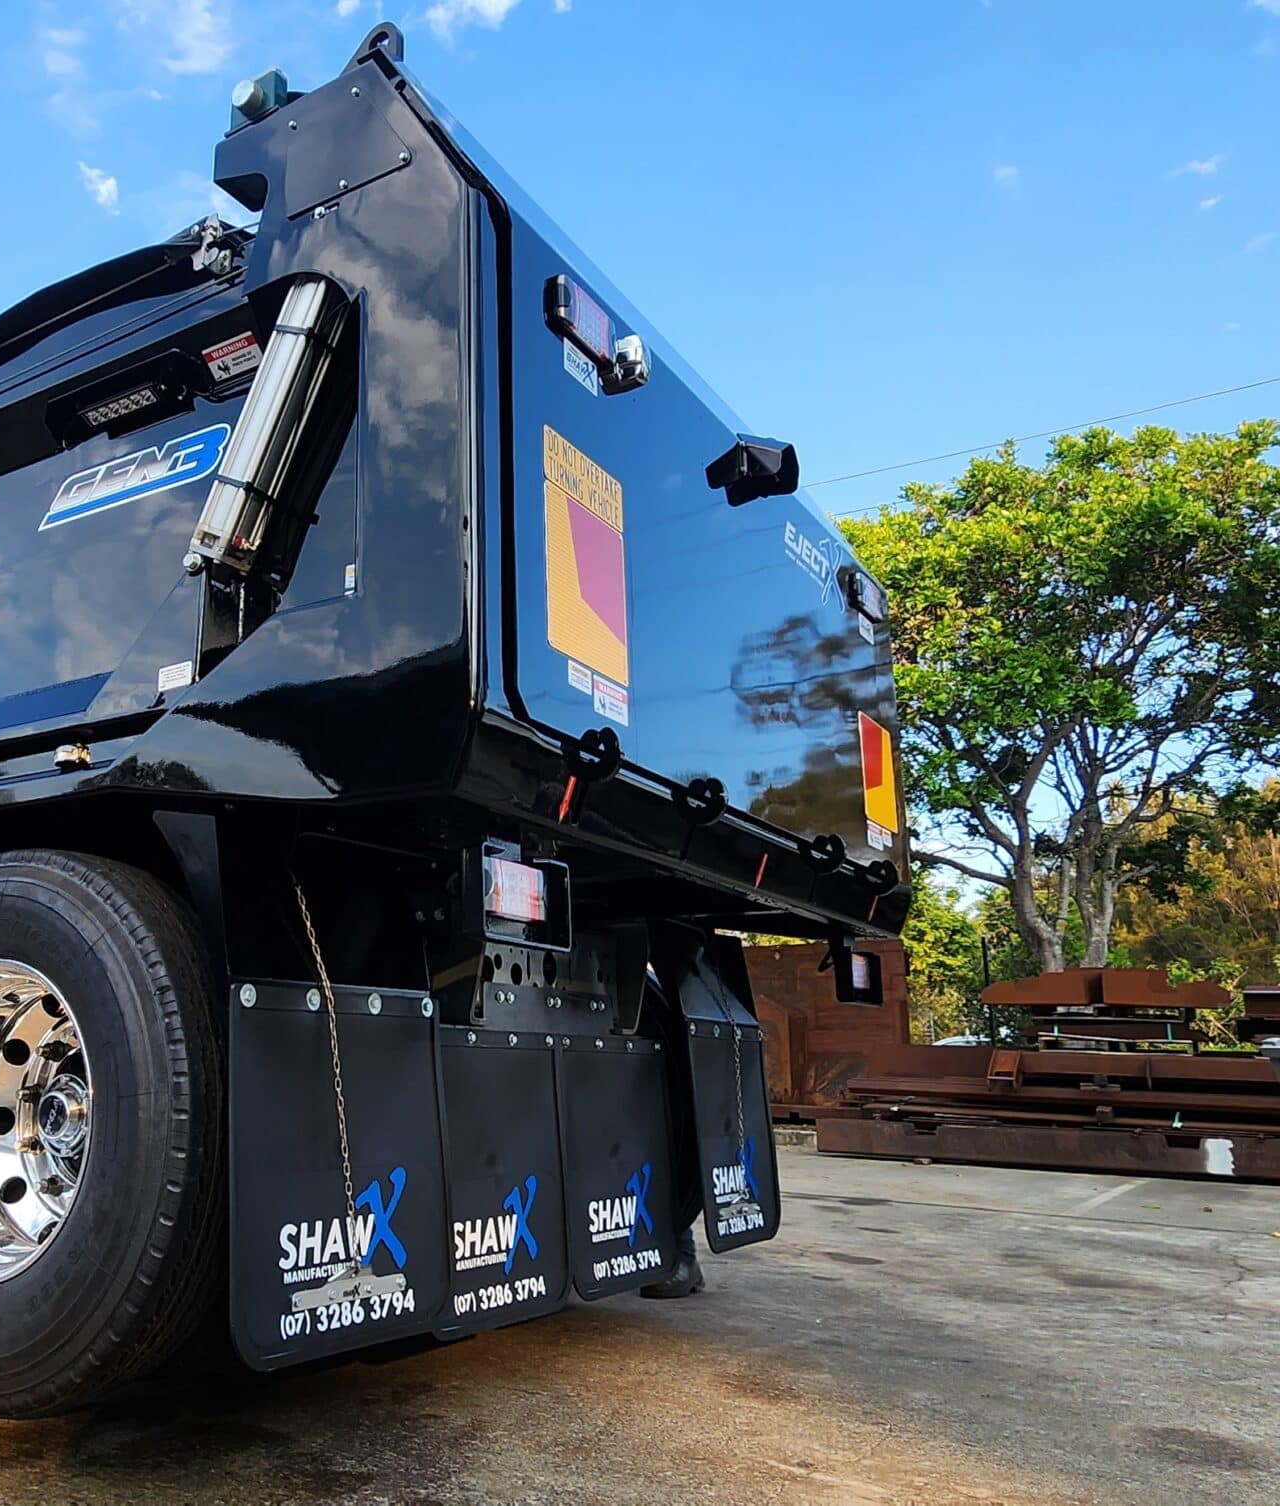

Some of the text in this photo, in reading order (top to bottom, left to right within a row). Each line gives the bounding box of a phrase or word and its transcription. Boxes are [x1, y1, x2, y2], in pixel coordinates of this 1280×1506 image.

[211, 339, 249, 359] WARNING
[548, 430, 618, 501] DO NOT OVERTAKE
[548, 456, 618, 526] TURNING VEHICLE
[594, 1249, 662, 1281] (07) 3286 3794
[280, 1308, 311, 1340] (07)
[316, 1299, 365, 1332] 3286
[370, 1288, 416, 1320] 3794
[454, 1275, 546, 1316] (07) 3286 3794
